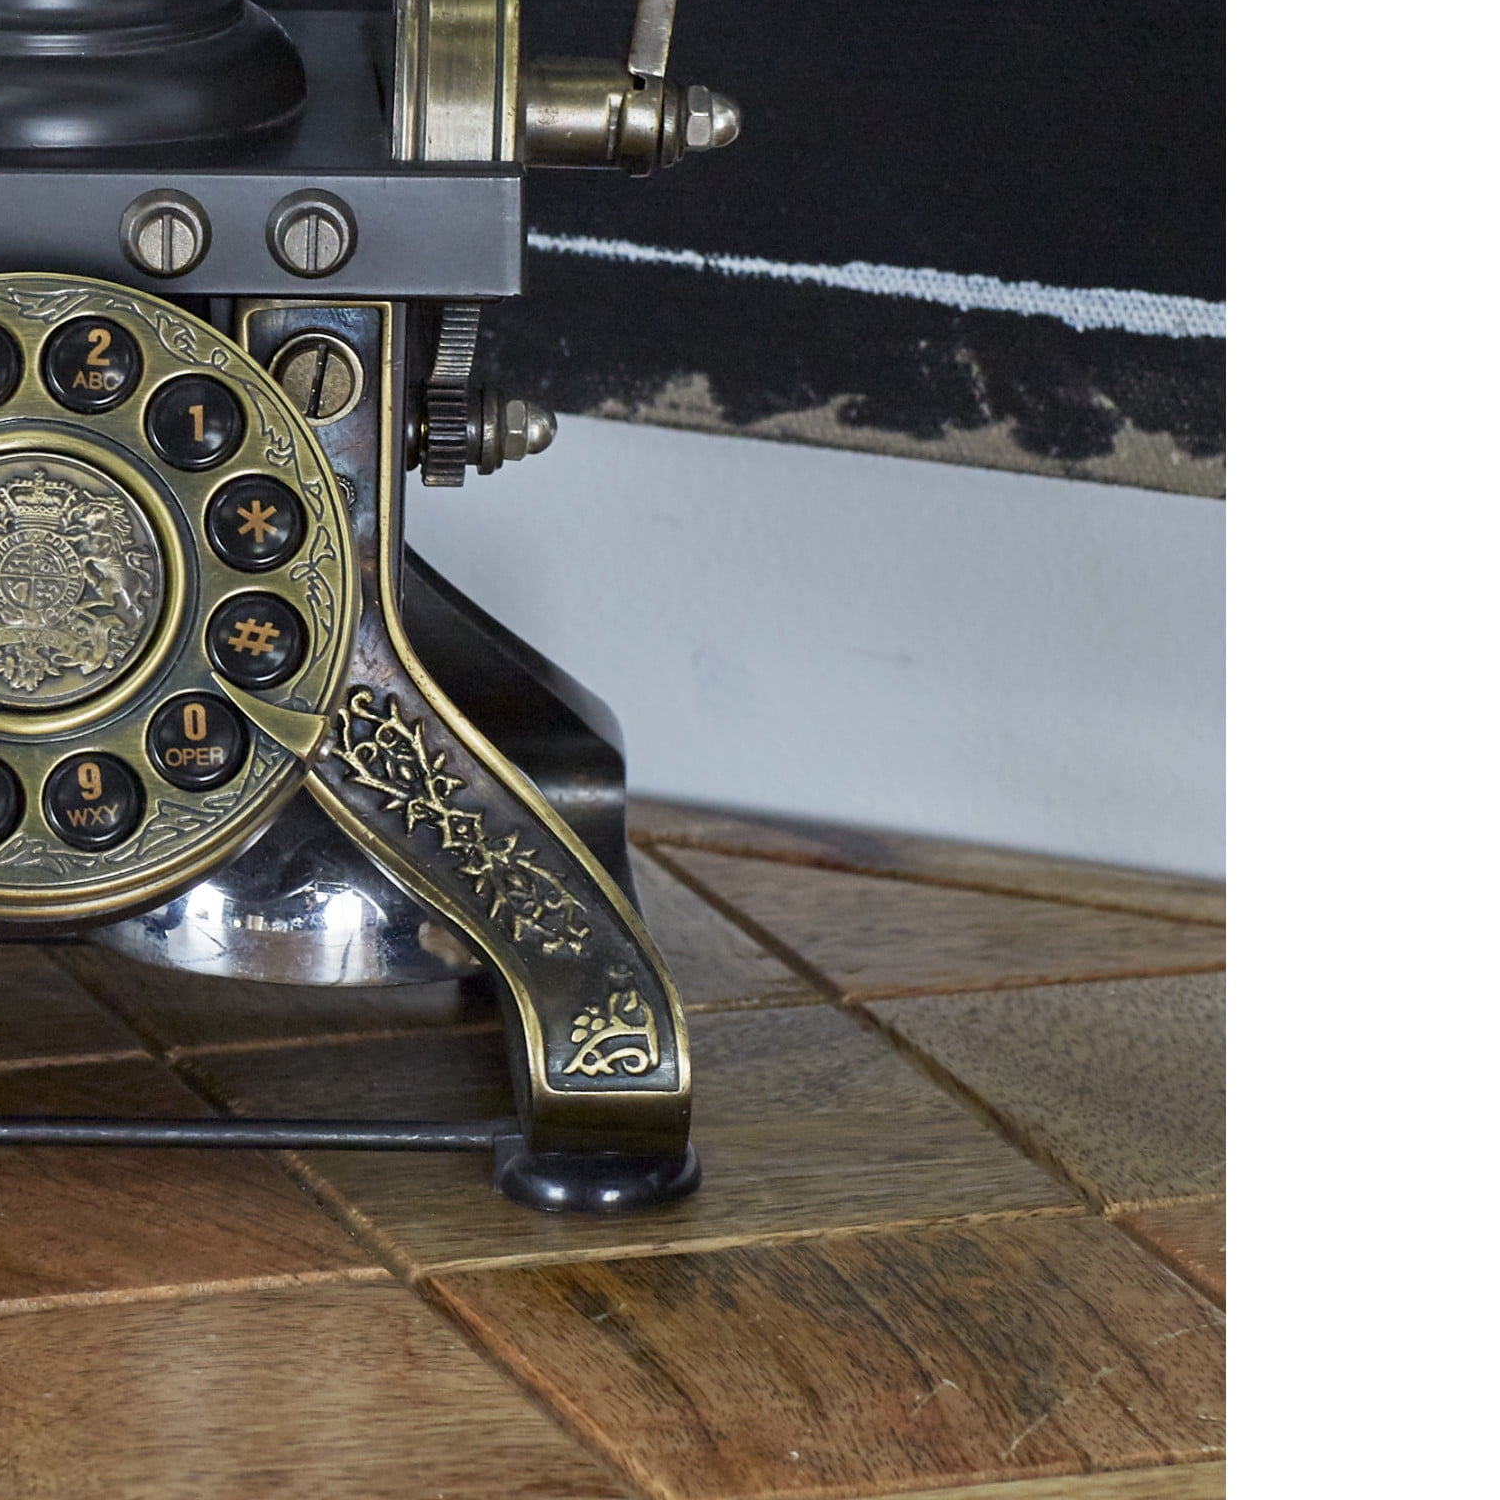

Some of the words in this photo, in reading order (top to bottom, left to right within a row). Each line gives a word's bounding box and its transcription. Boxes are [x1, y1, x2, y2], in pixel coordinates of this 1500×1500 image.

[86, 328, 112, 366] 2
[73, 371, 119, 392] ABC
[188, 405, 204, 441] 1
[228, 618, 280, 655] #
[183, 703, 207, 741] 0
[165, 747, 224, 768] OPER
[78, 762, 102, 800] 9
[67, 804, 119, 827] WXY
